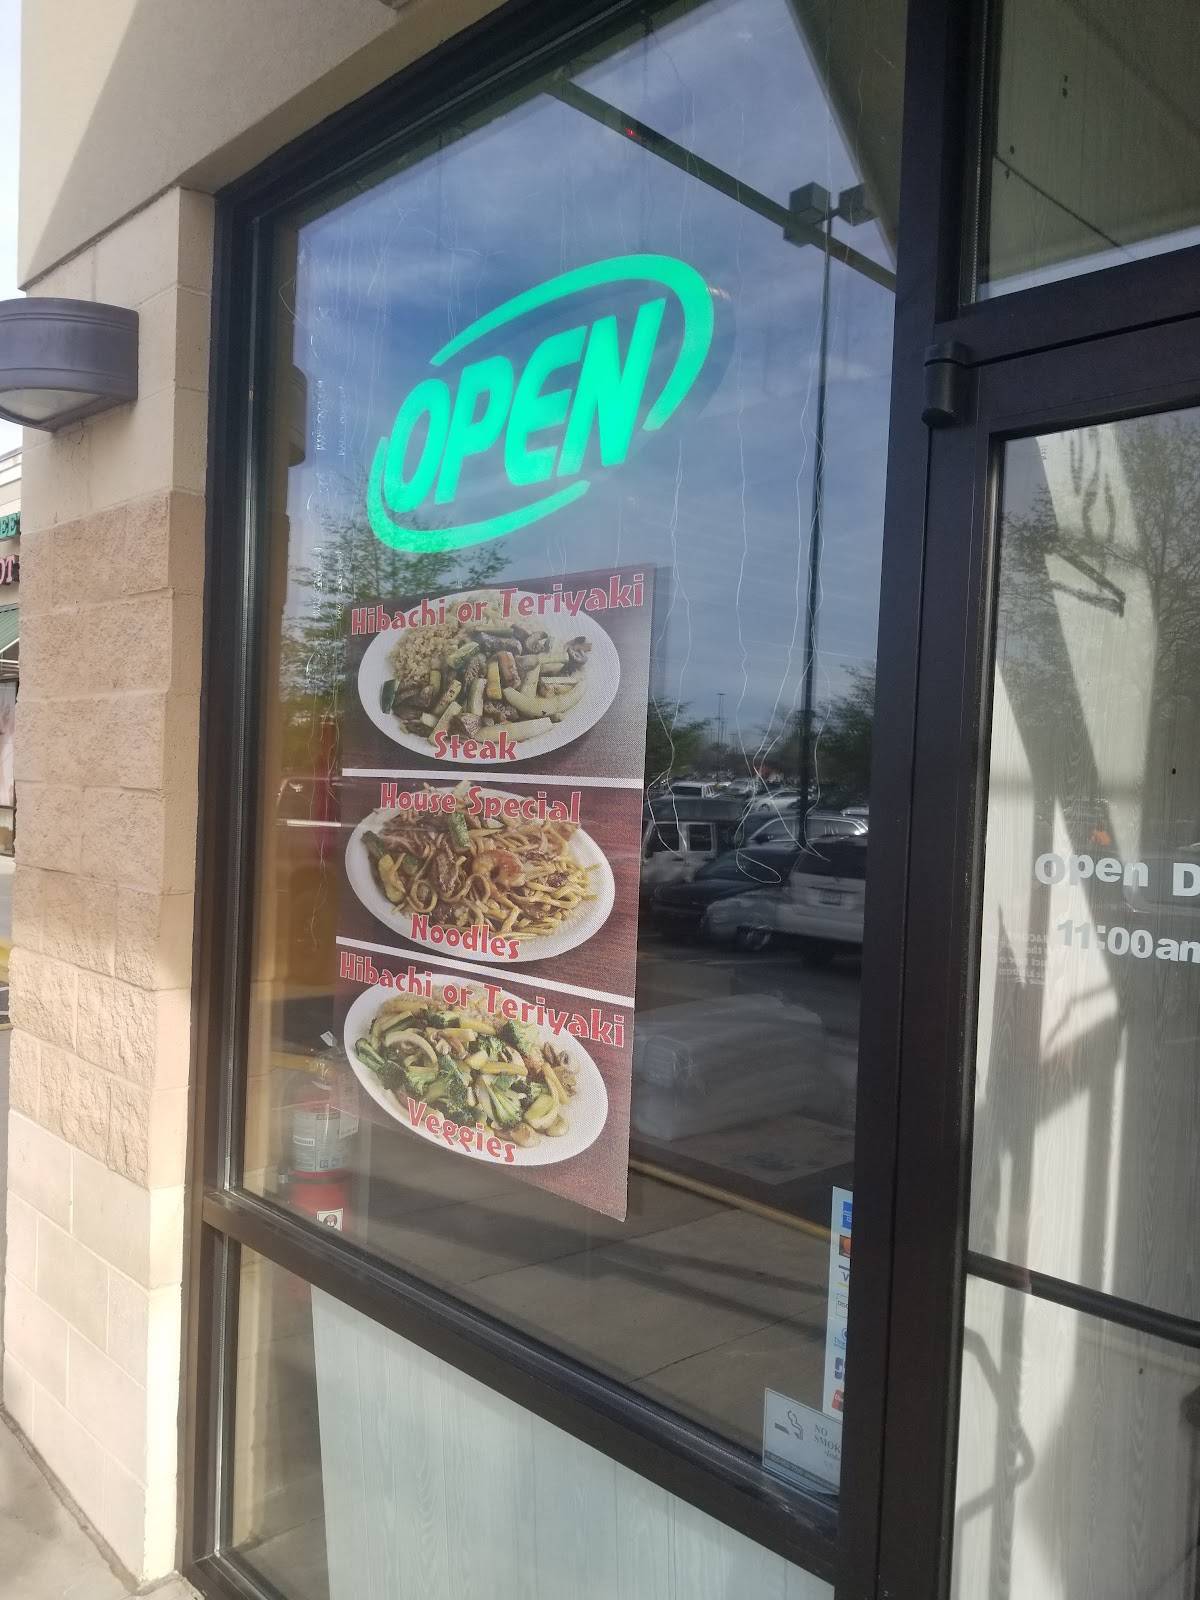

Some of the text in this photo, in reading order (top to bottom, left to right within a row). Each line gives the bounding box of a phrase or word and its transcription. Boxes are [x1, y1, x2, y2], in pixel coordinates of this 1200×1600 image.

[383, 297, 666, 513] OPEN
[351, 573, 645, 635] Hibachi or Teriyaki
[434, 729, 518, 761] Steak
[380, 782, 582, 823] House Special
[1034, 852, 1149, 887] Open
[410, 913, 520, 960] Noodles
[339, 951, 625, 1048] Hibachi or Teriyaki
[407, 1097, 516, 1163] Veggies
